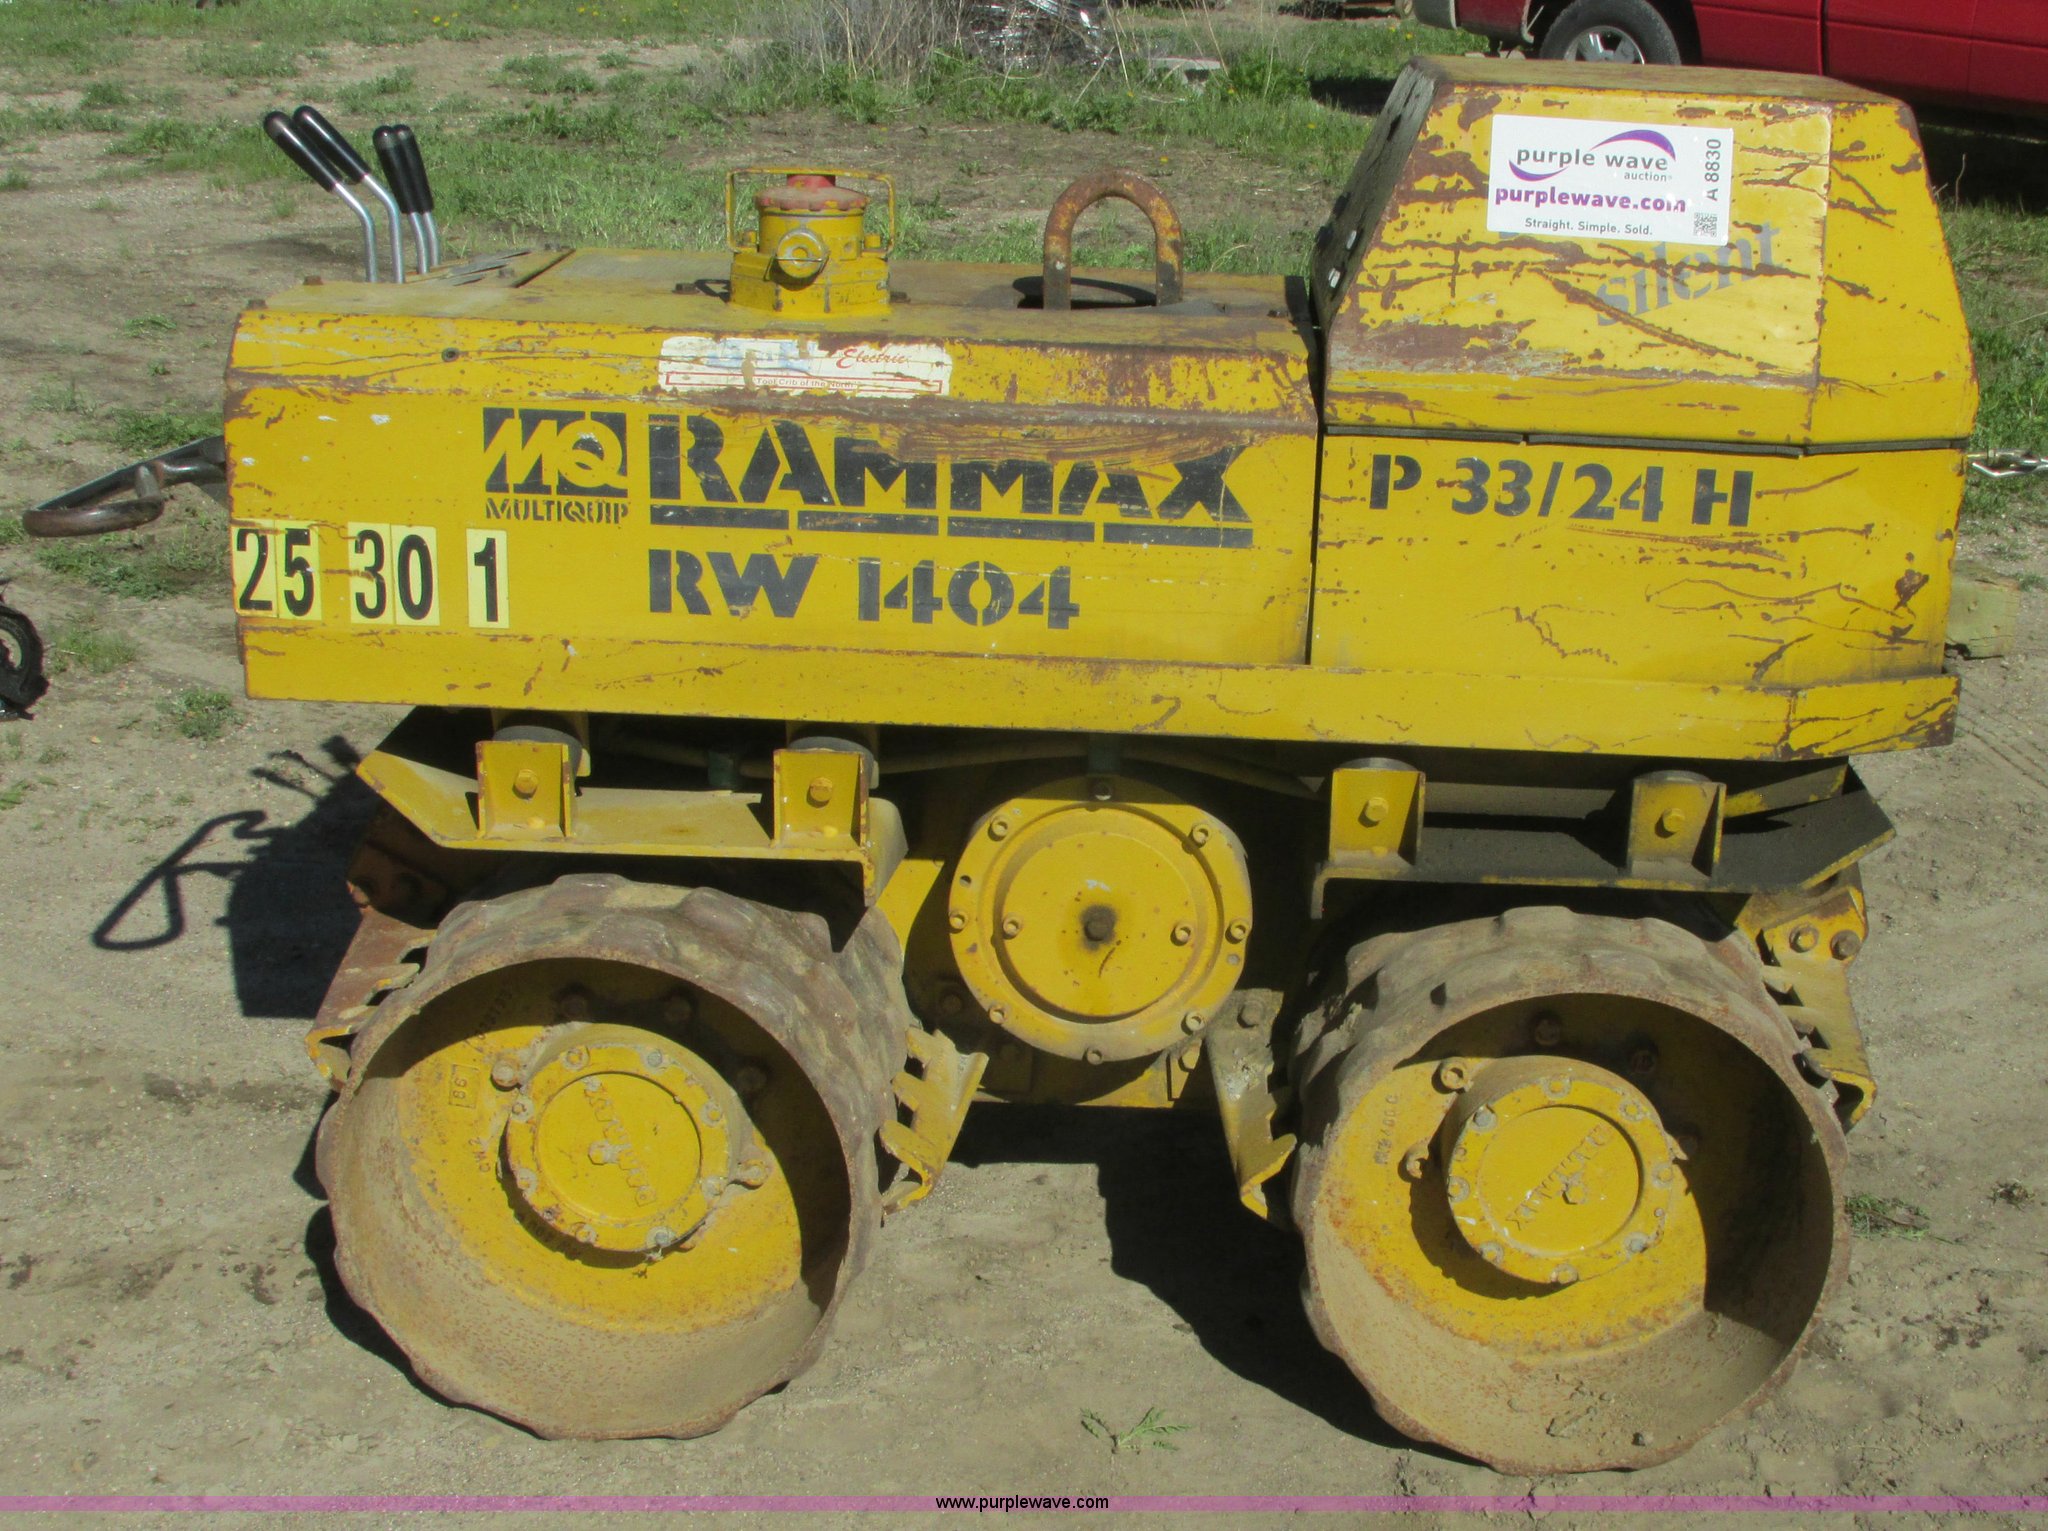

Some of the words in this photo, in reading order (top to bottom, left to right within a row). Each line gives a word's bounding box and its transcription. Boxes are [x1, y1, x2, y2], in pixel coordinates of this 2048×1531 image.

[1516, 148, 1595, 167] purple
[1605, 153, 1668, 171] wave
[1704, 138, 1721, 182] 8830
[1623, 171, 1668, 182] auction
[1495, 186, 1686, 213] purplewave.com
[1706, 188, 1718, 201] A
[1524, 217, 1574, 232] Straight.
[1578, 220, 1620, 234] Simple.
[1624, 224, 1653, 236] Sold.
[778, 378, 798, 387] Crib
[800, 379, 810, 387] of
[811, 380, 826, 388] the
[482, 407, 628, 499] MQ
[648, 414, 1253, 523] RAMMAX
[1369, 454, 1422, 510] P
[1451, 457, 1664, 523] 33/24
[1691, 468, 1754, 527] H
[485, 498, 629, 524] MULTIQUIP
[236, 527, 316, 616] 25
[354, 529, 434, 620] 30
[473, 537, 499, 623] 1
[648, 548, 818, 618] RW
[857, 556, 1081, 631] 1404
